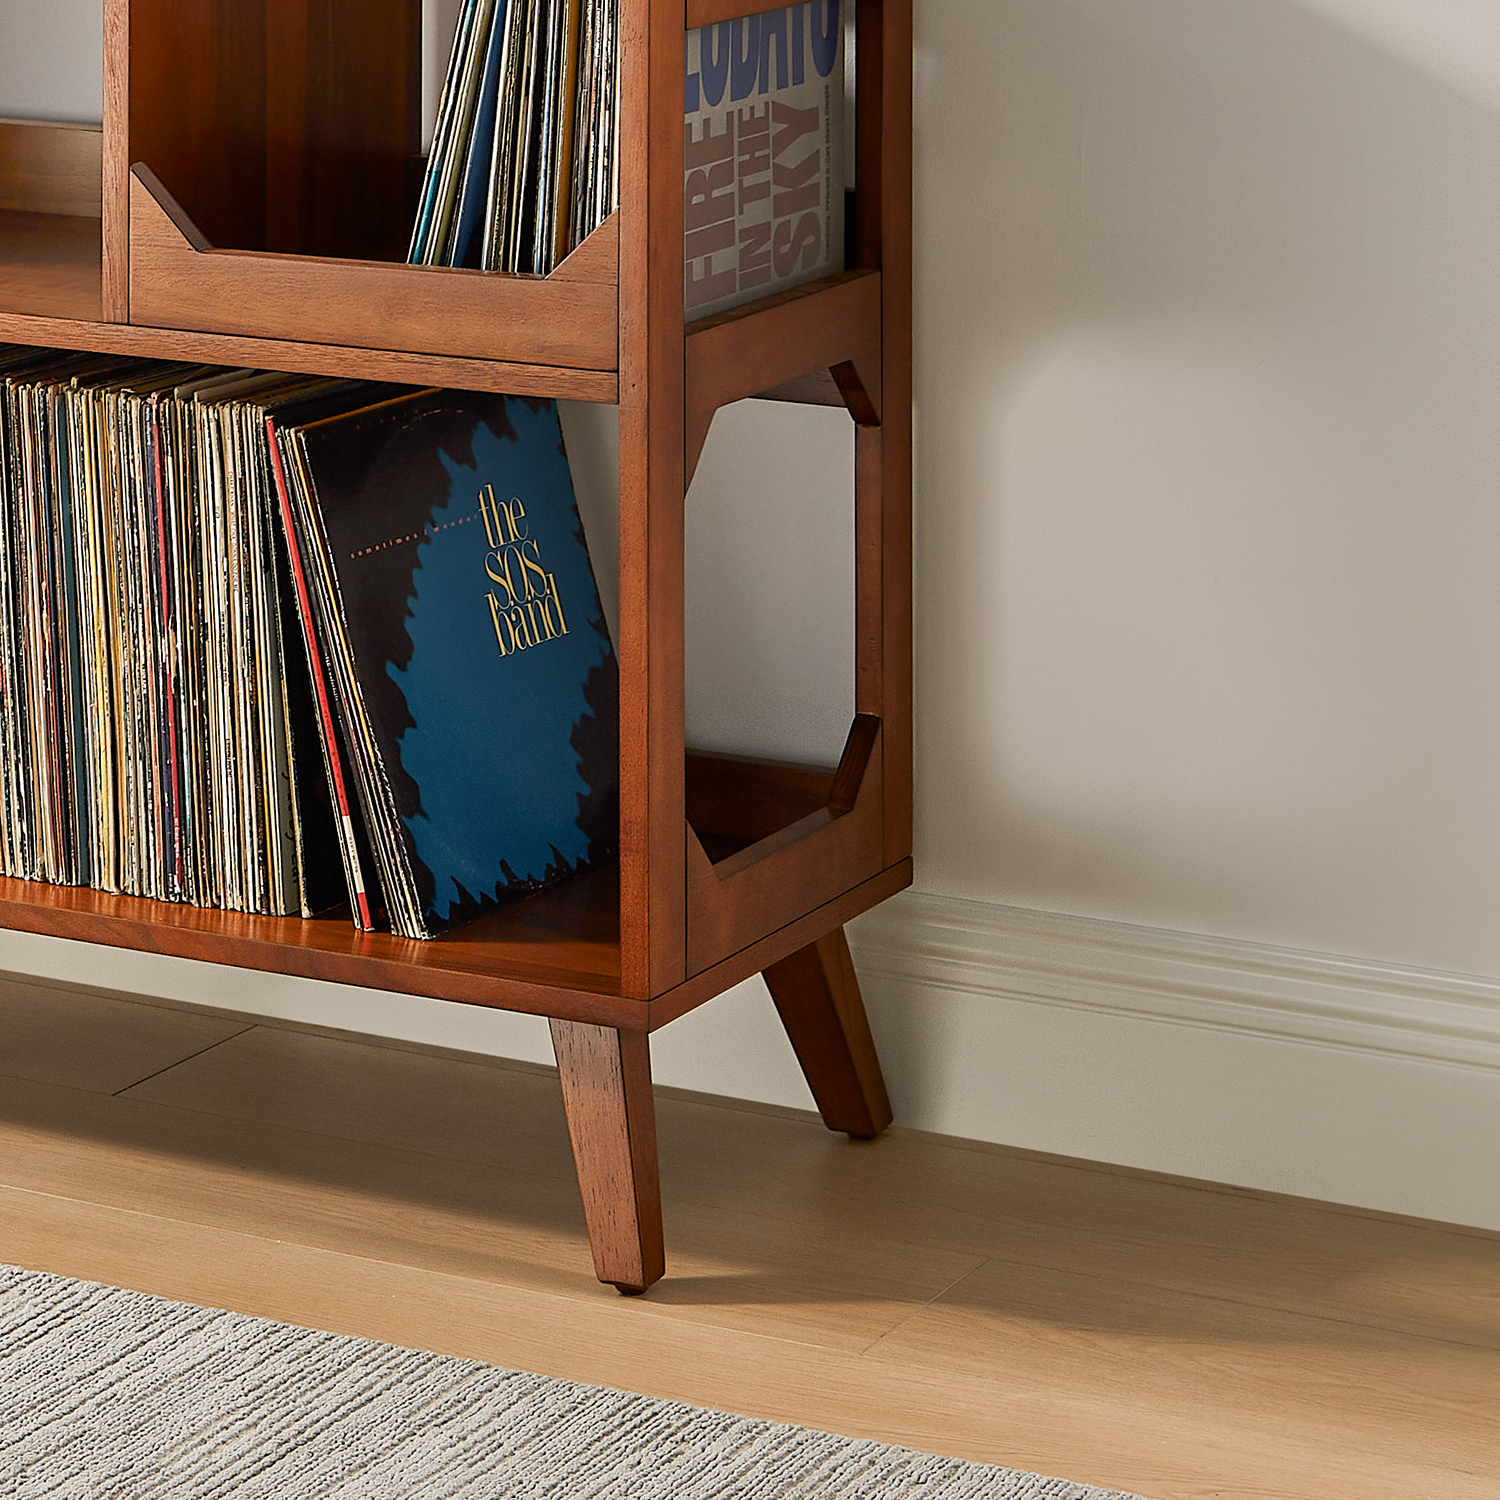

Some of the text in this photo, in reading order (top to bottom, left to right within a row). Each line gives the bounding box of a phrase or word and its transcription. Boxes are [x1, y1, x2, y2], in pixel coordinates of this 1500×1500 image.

[685, 110, 736, 309] FIRE
[737, 101, 772, 292] IN THE
[771, 100, 821, 278] SKY
[349, 531, 419, 560] sometimes
[478, 483, 529, 549] the
[484, 573, 571, 658] band
